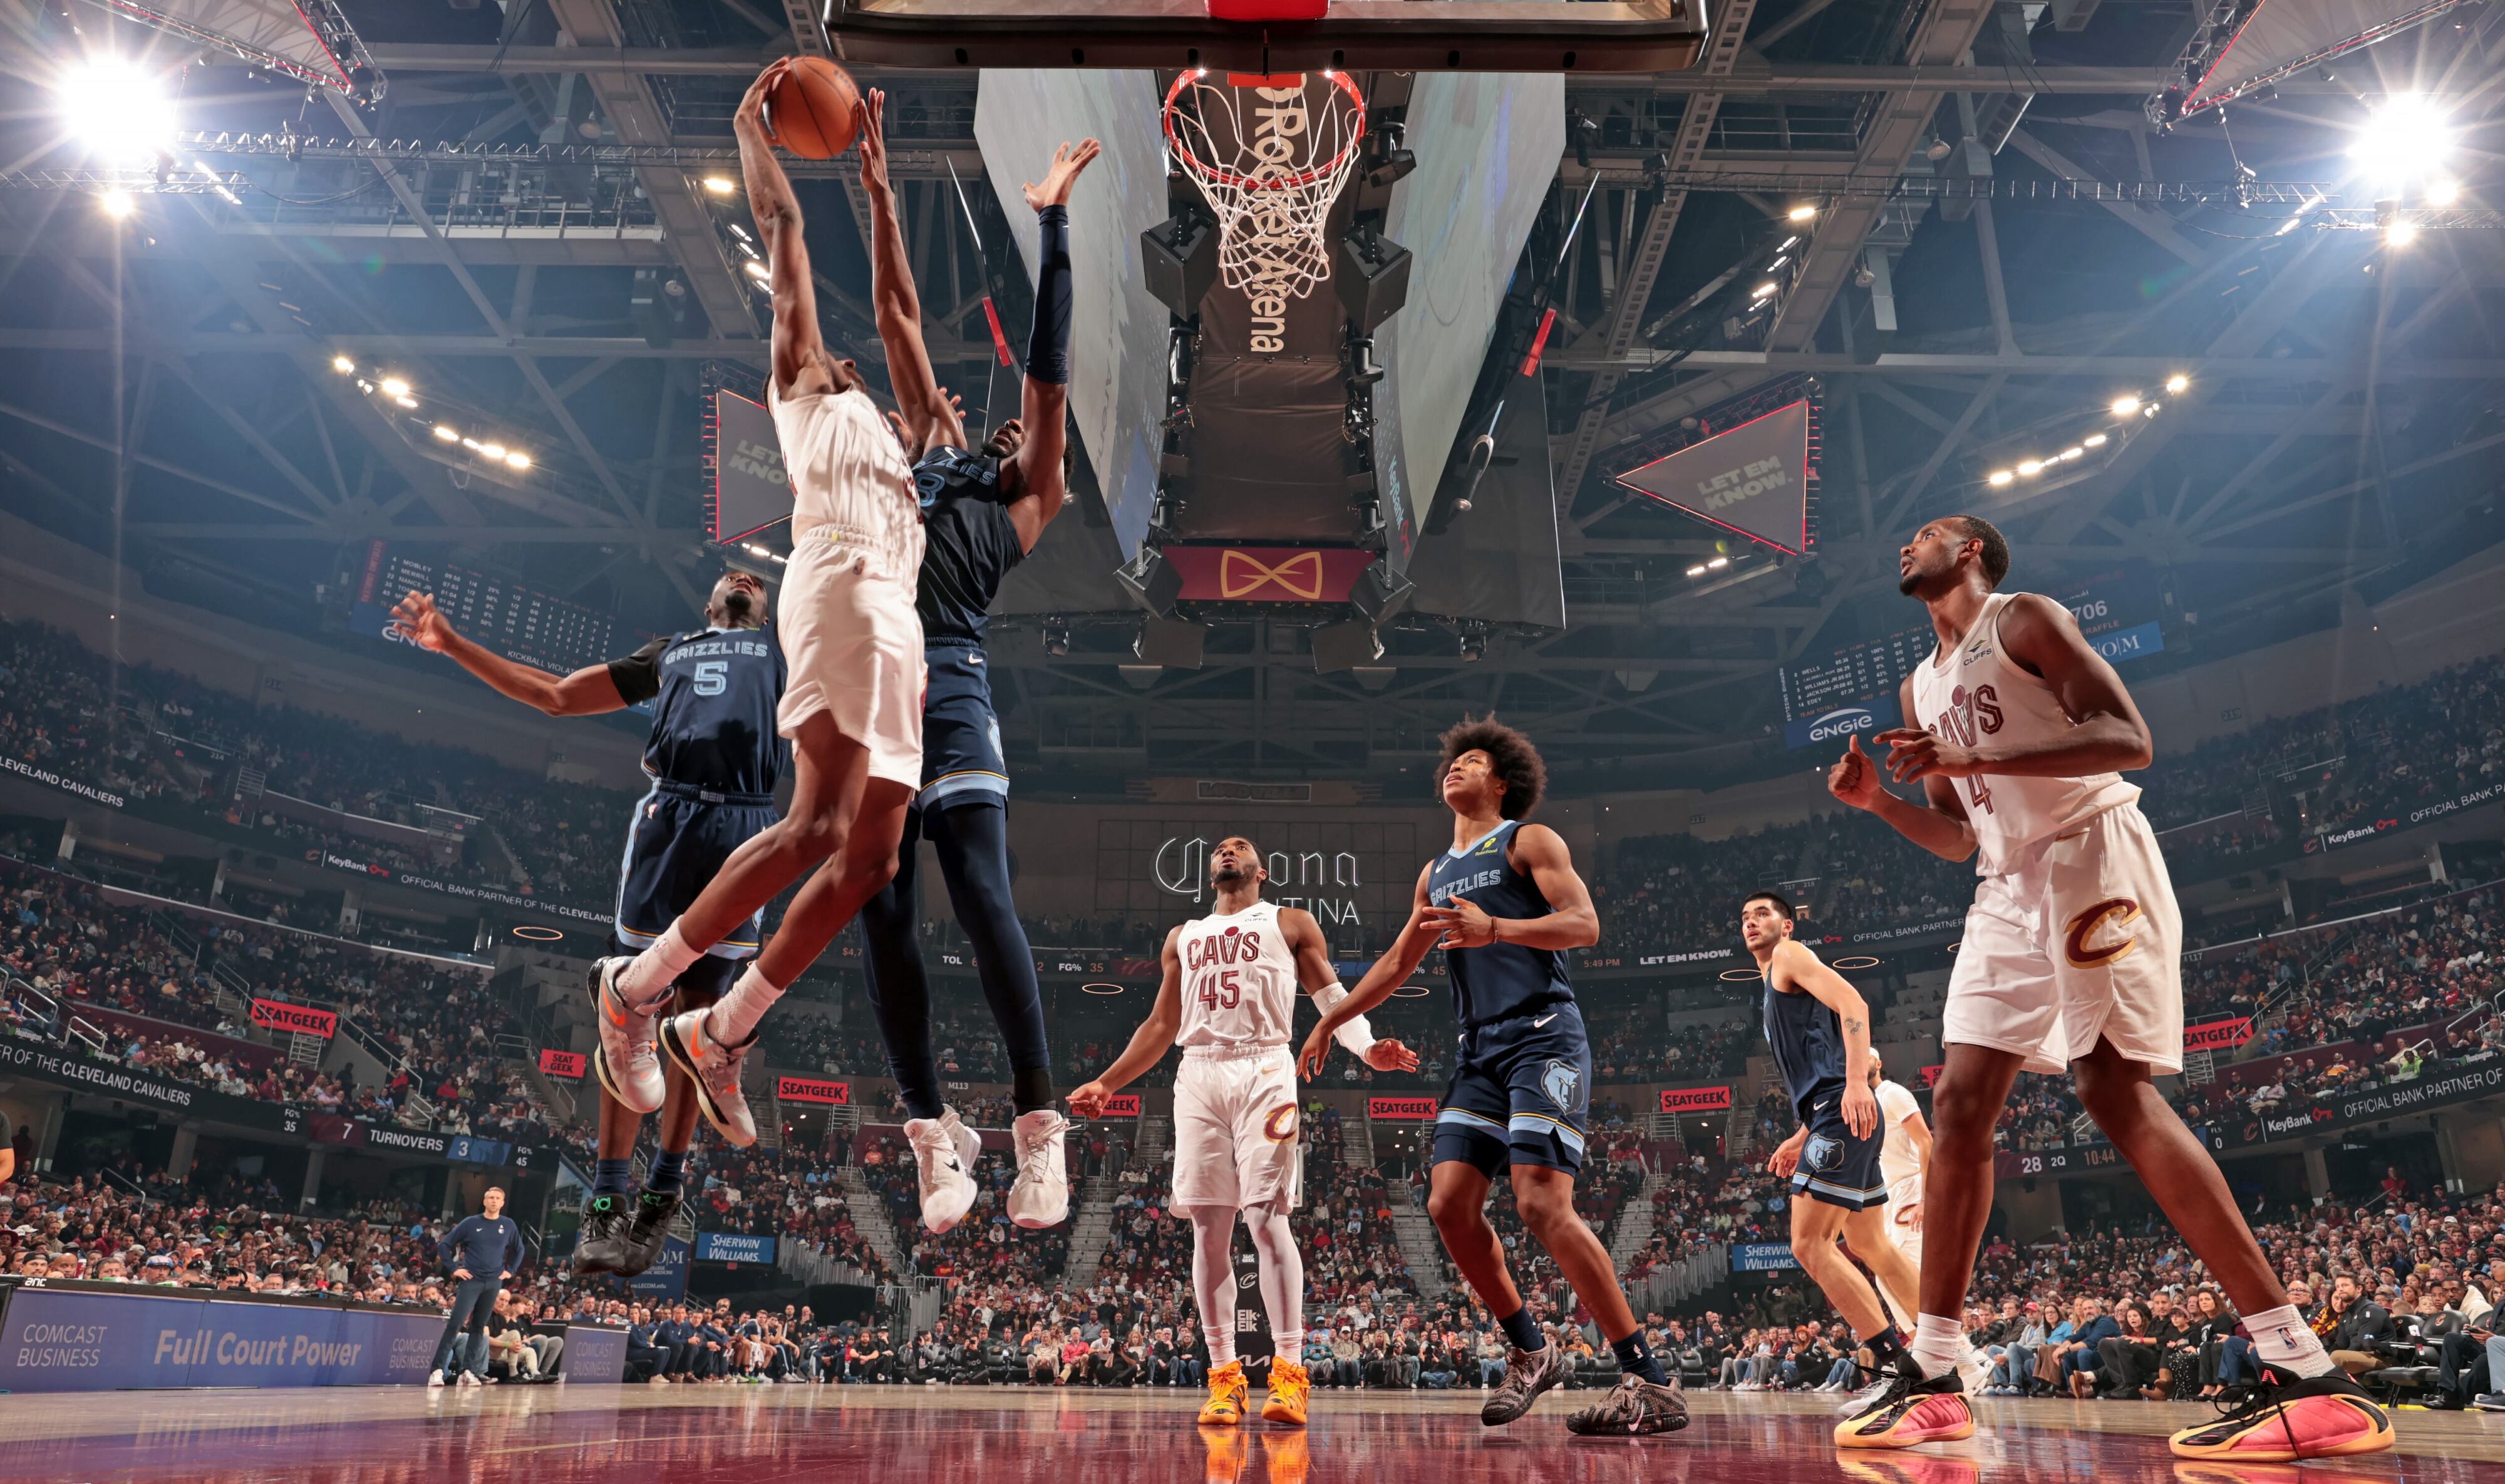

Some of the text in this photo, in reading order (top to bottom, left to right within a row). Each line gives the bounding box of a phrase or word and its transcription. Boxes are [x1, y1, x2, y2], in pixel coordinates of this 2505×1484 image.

[736, 440, 782, 465] LET
[728, 454, 788, 488] KNO
[1697, 455, 1782, 495] LET EM
[916, 472, 946, 507] 8
[403, 559, 432, 573] MOBLEY
[398, 577, 421, 587] NANCE
[401, 568, 430, 582] MERRILL
[507, 649, 577, 674] KICKBALL VIOLAT
[665, 641, 768, 665] GRIZZLIES
[1963, 648, 1992, 666] CLIFFS
[693, 661, 728, 696] 5
[1802, 666, 1820, 676] WELLS
[1804, 679, 1829, 690] WILLIAMS
[1805, 687, 1831, 698] JACKSON
[1807, 697, 1822, 705] EDEY
[1800, 708, 1815, 718] TEAM
[1816, 703, 1839, 713] TOTALS
[210, 751, 224, 761] 214
[0, 756, 124, 806] LEVELAND CAVALIERS
[1967, 774, 1994, 815] 4
[2328, 788, 2493, 844] KeyBank OFFICIAL BANK
[1475, 848, 1498, 857] Robinhood
[1151, 836, 1361, 902] Cona
[328, 855, 614, 924] KeyBank OFFICIAL BANK PARTNER OF THE CLEVELAND
[1430, 869, 1501, 907] GRIZZLIES
[1854, 931, 1894, 942] OFFICIAL
[1896, 927, 1921, 937] BANK
[1923, 919, 1965, 932] PARTNER
[1187, 932, 1260, 971] CAVS
[943, 956, 963, 965] TOL
[1058, 963, 1082, 971] FG%
[1090, 962, 1104, 972] 35
[1584, 959, 1603, 968] 5:49
[1606, 959, 1621, 967] PM
[1640, 956, 1665, 965] LET
[1667, 954, 1687, 963] EM
[1432, 966, 1446, 976] 45
[1198, 970, 1239, 1011] 45
[254, 1004, 331, 1033] SEATGEEK
[2183, 1023, 2249, 1046] EATGEEK
[553, 1054, 574, 1063] SEAT
[550, 1063, 573, 1073] GEEK
[14, 1049, 191, 1106] OF THE CLEVELAND CAVALIERS
[948, 1081, 969, 1090] M113
[782, 1081, 844, 1100] SEATGEEK
[1665, 1091, 1727, 1108] SEATGEEK
[2267, 1113, 2312, 1133] KeyBank
[2344, 1098, 2391, 1118] OFFICIAL
[2393, 1087, 2424, 1106] BANK
[2427, 1074, 2484, 1098] PARTNER
[2486, 1068, 2503, 1085] OF
[284, 1108, 301, 1118] FG%
[1373, 1102, 1433, 1115] SEATGEEK
[284, 1120, 468, 1157] 35 7 TURNOVERS 3
[2215, 1137, 2223, 1149] 0
[517, 1146, 533, 1155] FG%
[515, 1157, 528, 1167] 45
[2022, 1148, 2115, 1173] 28 2Q 10:44
[711, 1234, 760, 1249] SHERWIN
[1745, 1245, 1792, 1257] SHERWIN
[23, 1324, 108, 1344] COMCAST
[1237, 1321, 1258, 1332] Elk
[153, 1329, 361, 1367] Full Court Power
[392, 1338, 435, 1353] COMCAST
[576, 1341, 614, 1358] COMCAST
[16, 1348, 100, 1367] BUSINESS
[389, 1355, 431, 1369] BUSINESS
[573, 1361, 611, 1376] BUSINESS
